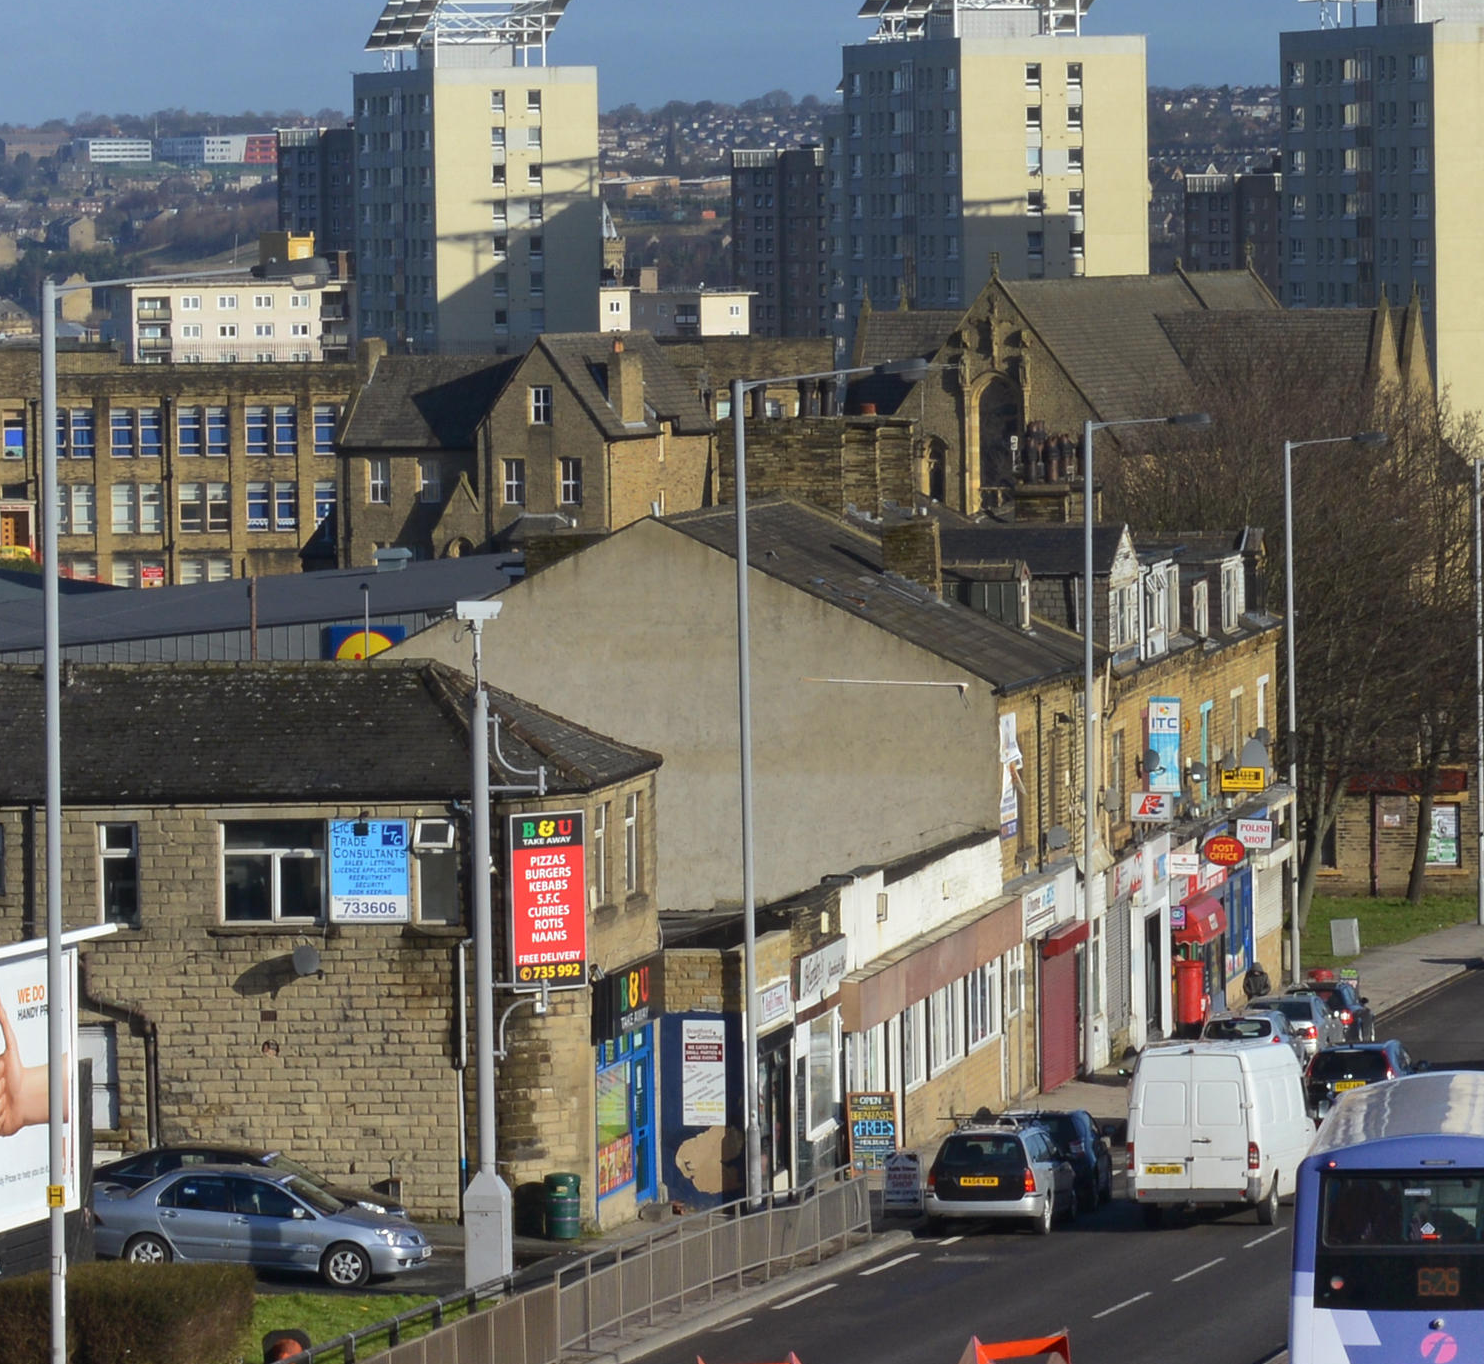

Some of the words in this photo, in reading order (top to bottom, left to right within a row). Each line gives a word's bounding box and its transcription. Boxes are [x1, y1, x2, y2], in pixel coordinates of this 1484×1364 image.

[1151, 717, 1177, 729] ITC
[1240, 823, 1270, 833] POLISH
[333, 835, 367, 847] TRADE
[522, 838, 544, 846] TAKE
[546, 836, 571, 844] AWAY
[1243, 835, 1266, 844] SHOP
[333, 847, 406, 859] CONSULTANTS
[1212, 843, 1236, 852] POST
[530, 854, 566, 866] PIZZAS
[1209, 852, 1239, 861] OFFICE
[525, 866, 571, 879] BURGERS
[529, 880, 568, 892] KEBABS
[537, 892, 560, 905] S.F.C
[344, 902, 397, 914] 733606
[527, 905, 570, 918] CURRIES
[534, 917, 564, 930] ROTIS
[531, 930, 567, 943] NAANS
[519, 954, 539, 964] FREE
[541, 950, 581, 963] DELIVERY
[533, 965, 555, 979] 735
[557, 964, 581, 976] 992
[17, 988, 30, 1004] WE
[31, 985, 45, 1001] DO
[17, 1006, 38, 1021] HANDY
[621, 1012, 634, 1029] TAKE
[635, 1006, 649, 1023] AWAY
[859, 1096, 882, 1105] OPEN
[859, 1120, 889, 1136] FREE
